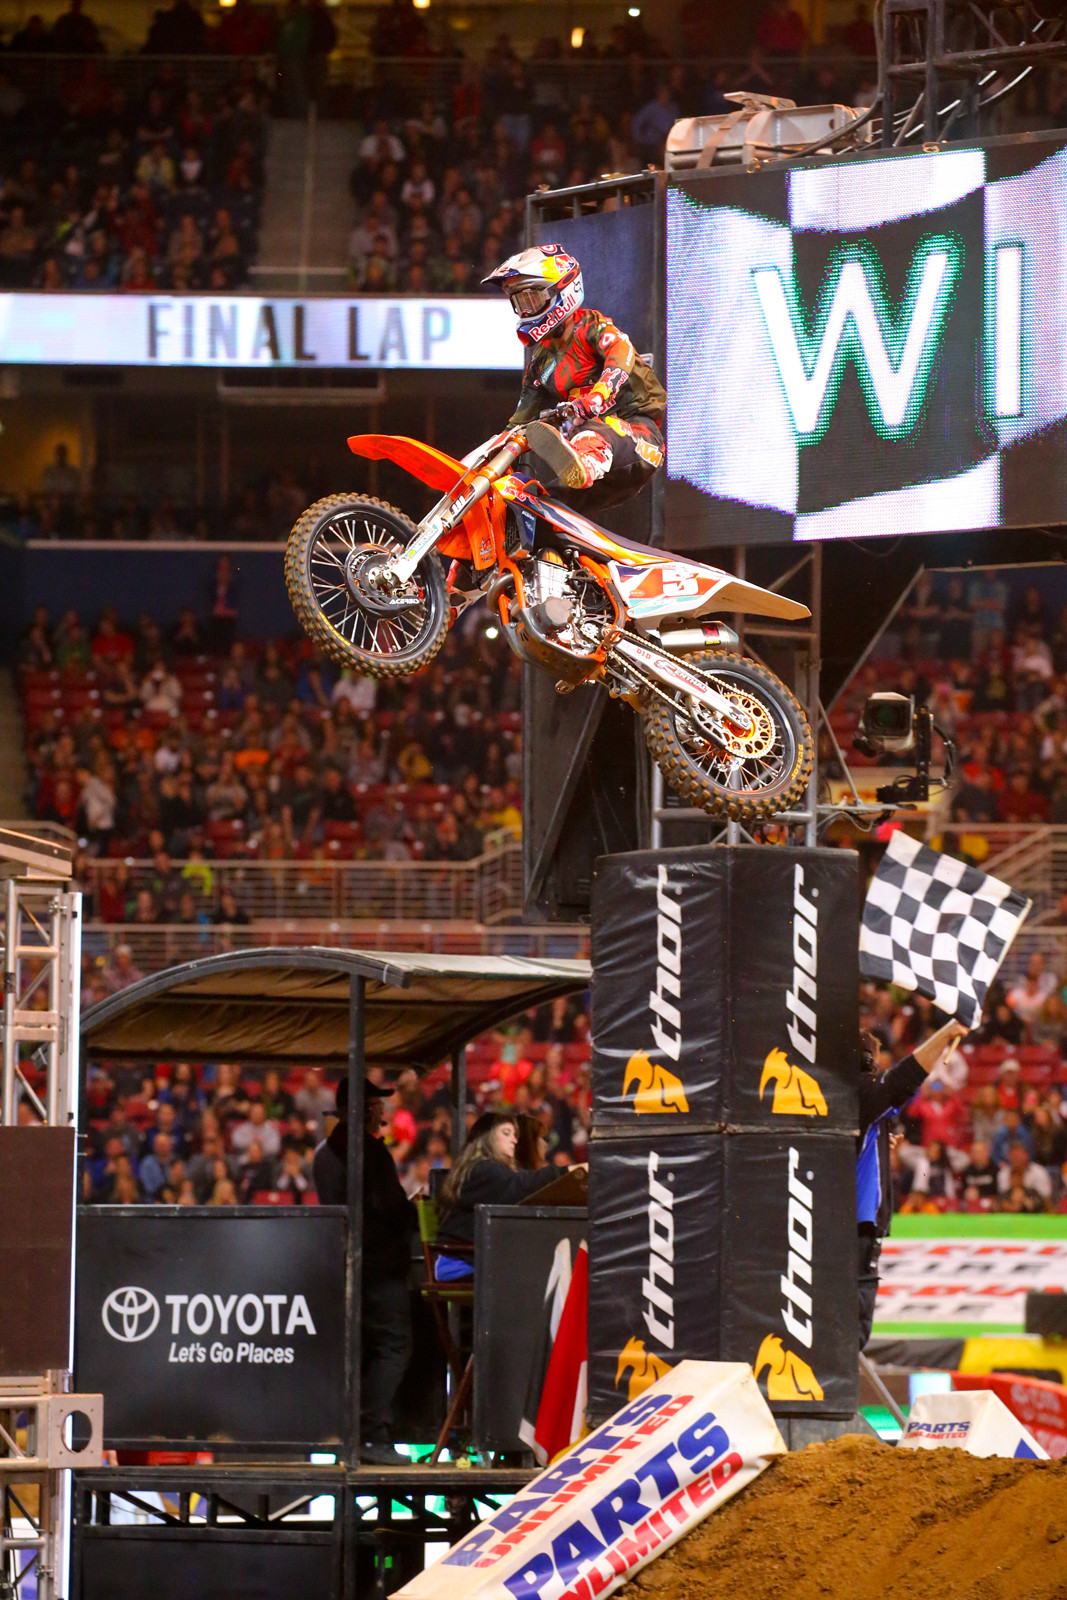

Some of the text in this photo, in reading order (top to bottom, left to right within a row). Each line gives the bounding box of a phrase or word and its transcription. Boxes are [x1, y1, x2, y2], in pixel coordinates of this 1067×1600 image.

[147, 301, 451, 362] FINAL LAP
[529, 294, 576, 342] Red Bull
[636, 438, 662, 467] KTM
[636, 647, 652, 660] DID
[791, 743, 804, 780] DUNLOP
[649, 863, 683, 1062] thor
[786, 863, 819, 1064] thor
[642, 1150, 675, 1350] thor
[780, 1146, 814, 1349] thor
[165, 1293, 317, 1335] TOYOTA
[168, 1342, 295, 1364] Let's Go Places
[907, 1421, 971, 1433] PARTS
[441, 1393, 673, 1567] PARTS
[473, 1394, 695, 1568] UNLIMITED
[503, 1411, 731, 1600] PARTS
[558, 1451, 744, 1600] NLIMITED
